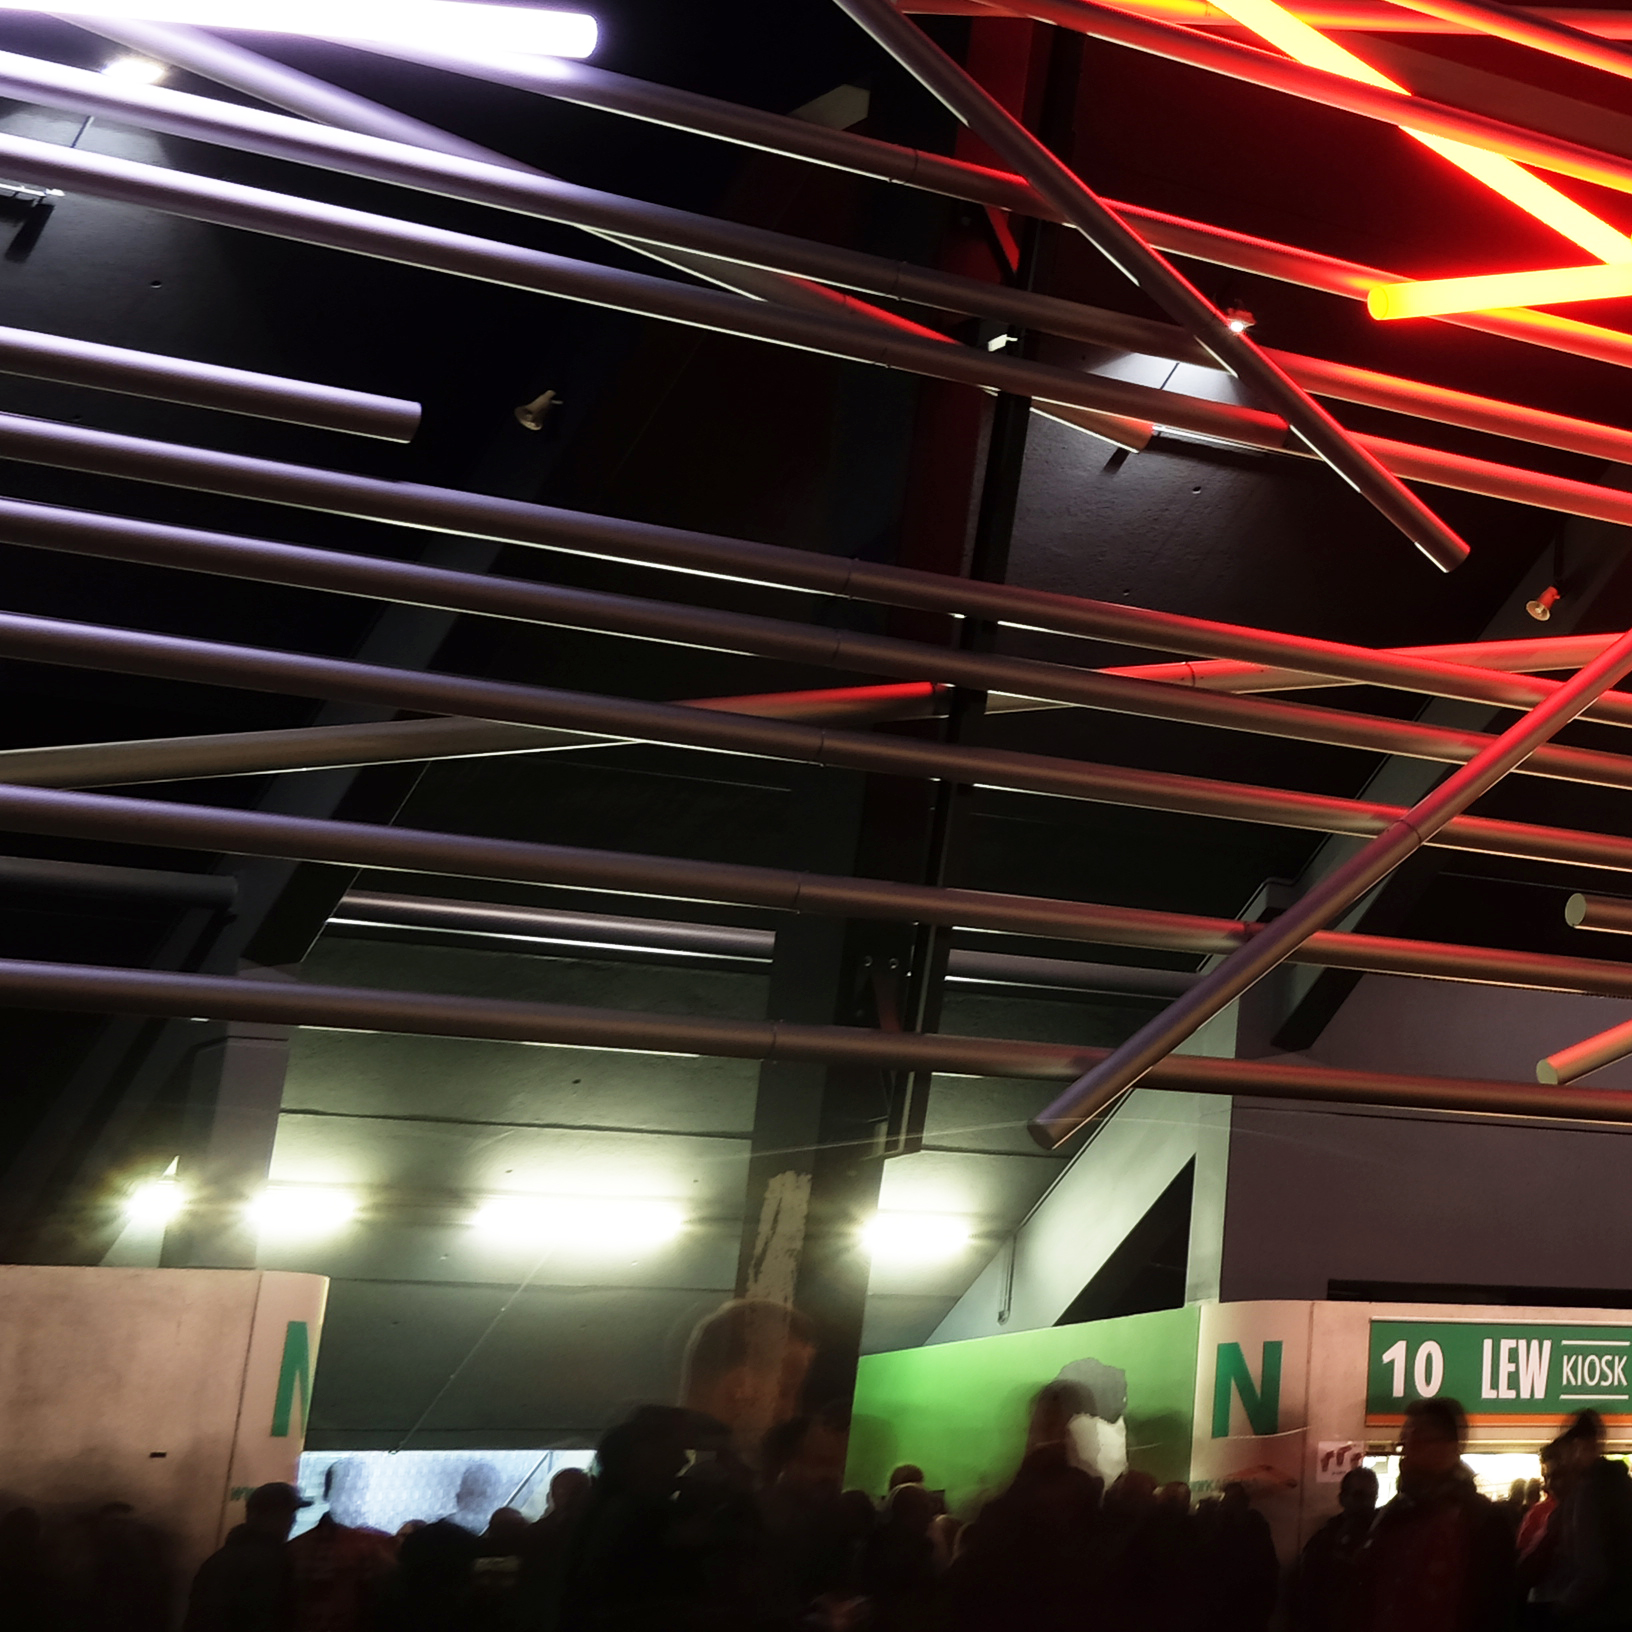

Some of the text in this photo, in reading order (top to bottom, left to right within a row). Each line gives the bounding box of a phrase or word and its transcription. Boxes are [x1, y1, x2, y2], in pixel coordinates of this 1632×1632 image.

[1211, 1340, 1283, 1438] N
[1382, 1339, 1444, 1398] 10
[1480, 1338, 1552, 1400] LEW
[1561, 1354, 1629, 1387] KIOSK
